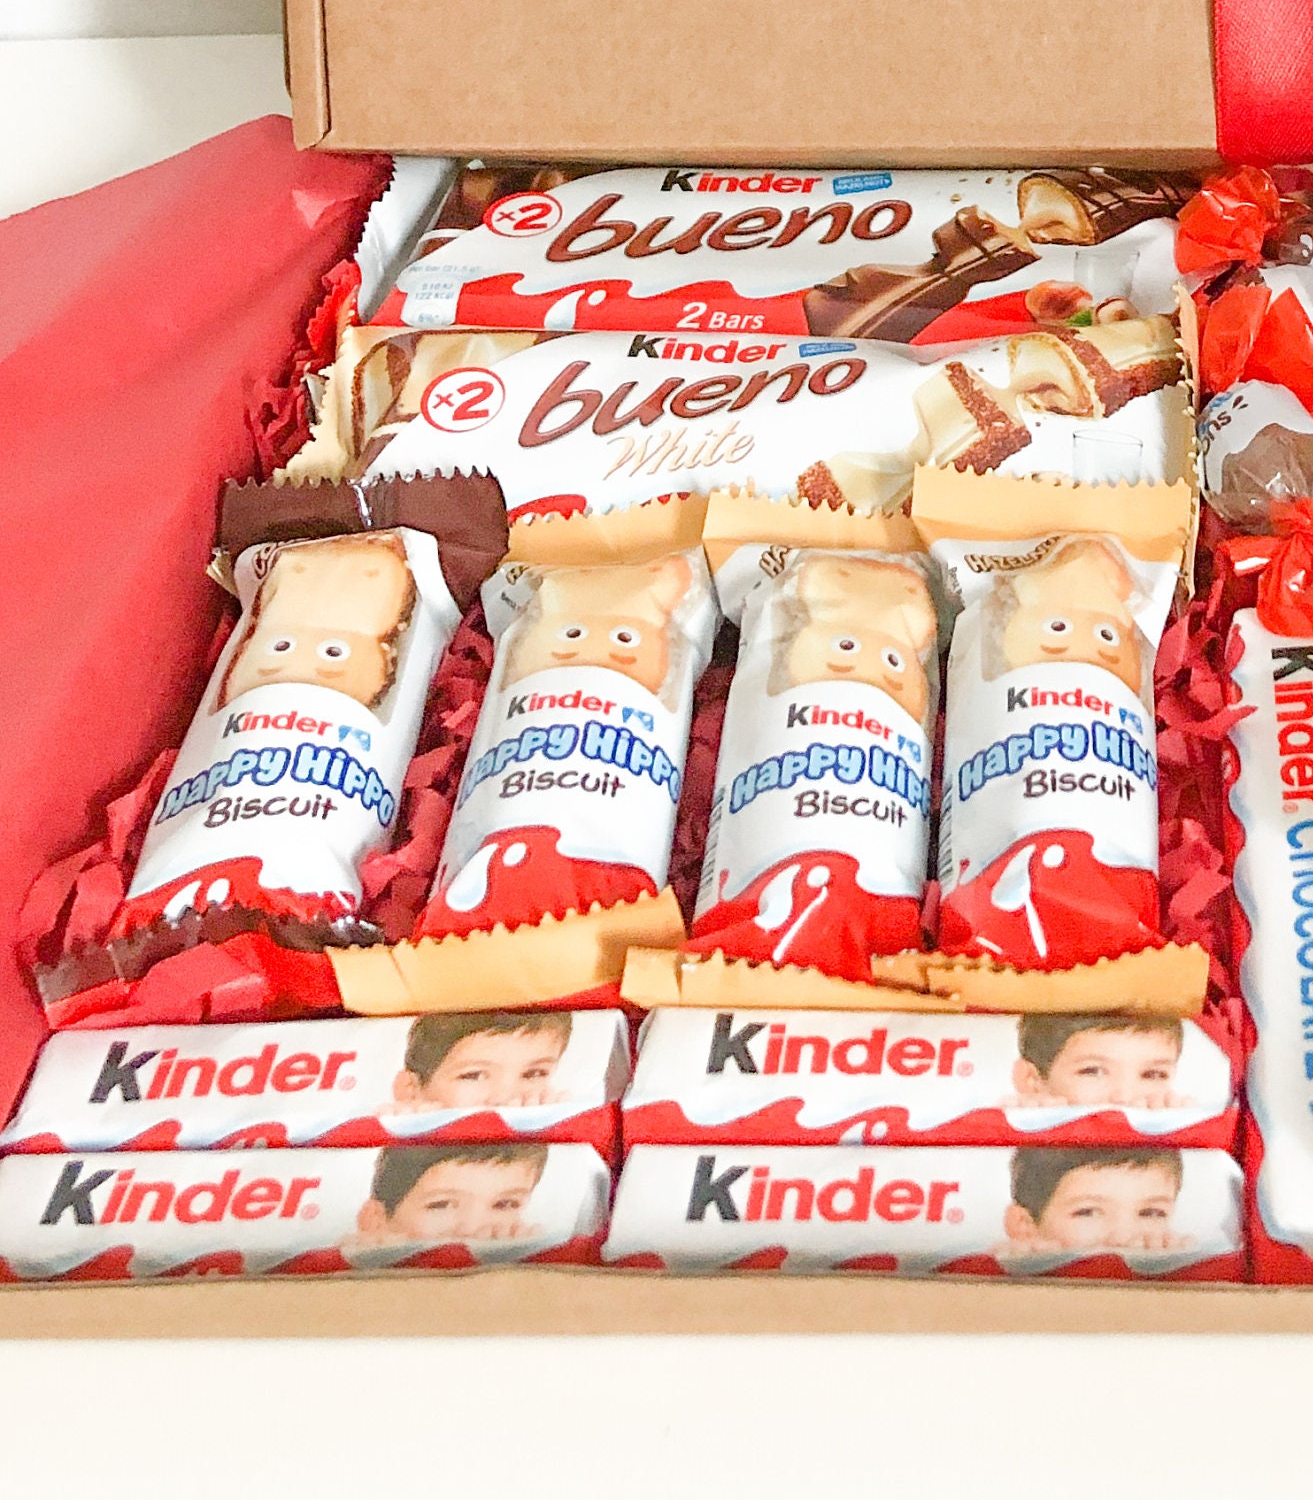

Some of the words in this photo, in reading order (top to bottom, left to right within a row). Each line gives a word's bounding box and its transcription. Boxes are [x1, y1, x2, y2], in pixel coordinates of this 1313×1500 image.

[546, 193, 913, 263] bueno
[676, 302, 707, 329] 2
[708, 311, 765, 330] Bars
[518, 357, 868, 449] bueno
[601, 420, 756, 481] White
[498, 769, 626, 799] Biscuit
[1023, 769, 1136, 801] Biscuit
[203, 793, 338, 829] Biscuit
[793, 789, 908, 828] Biscuit
